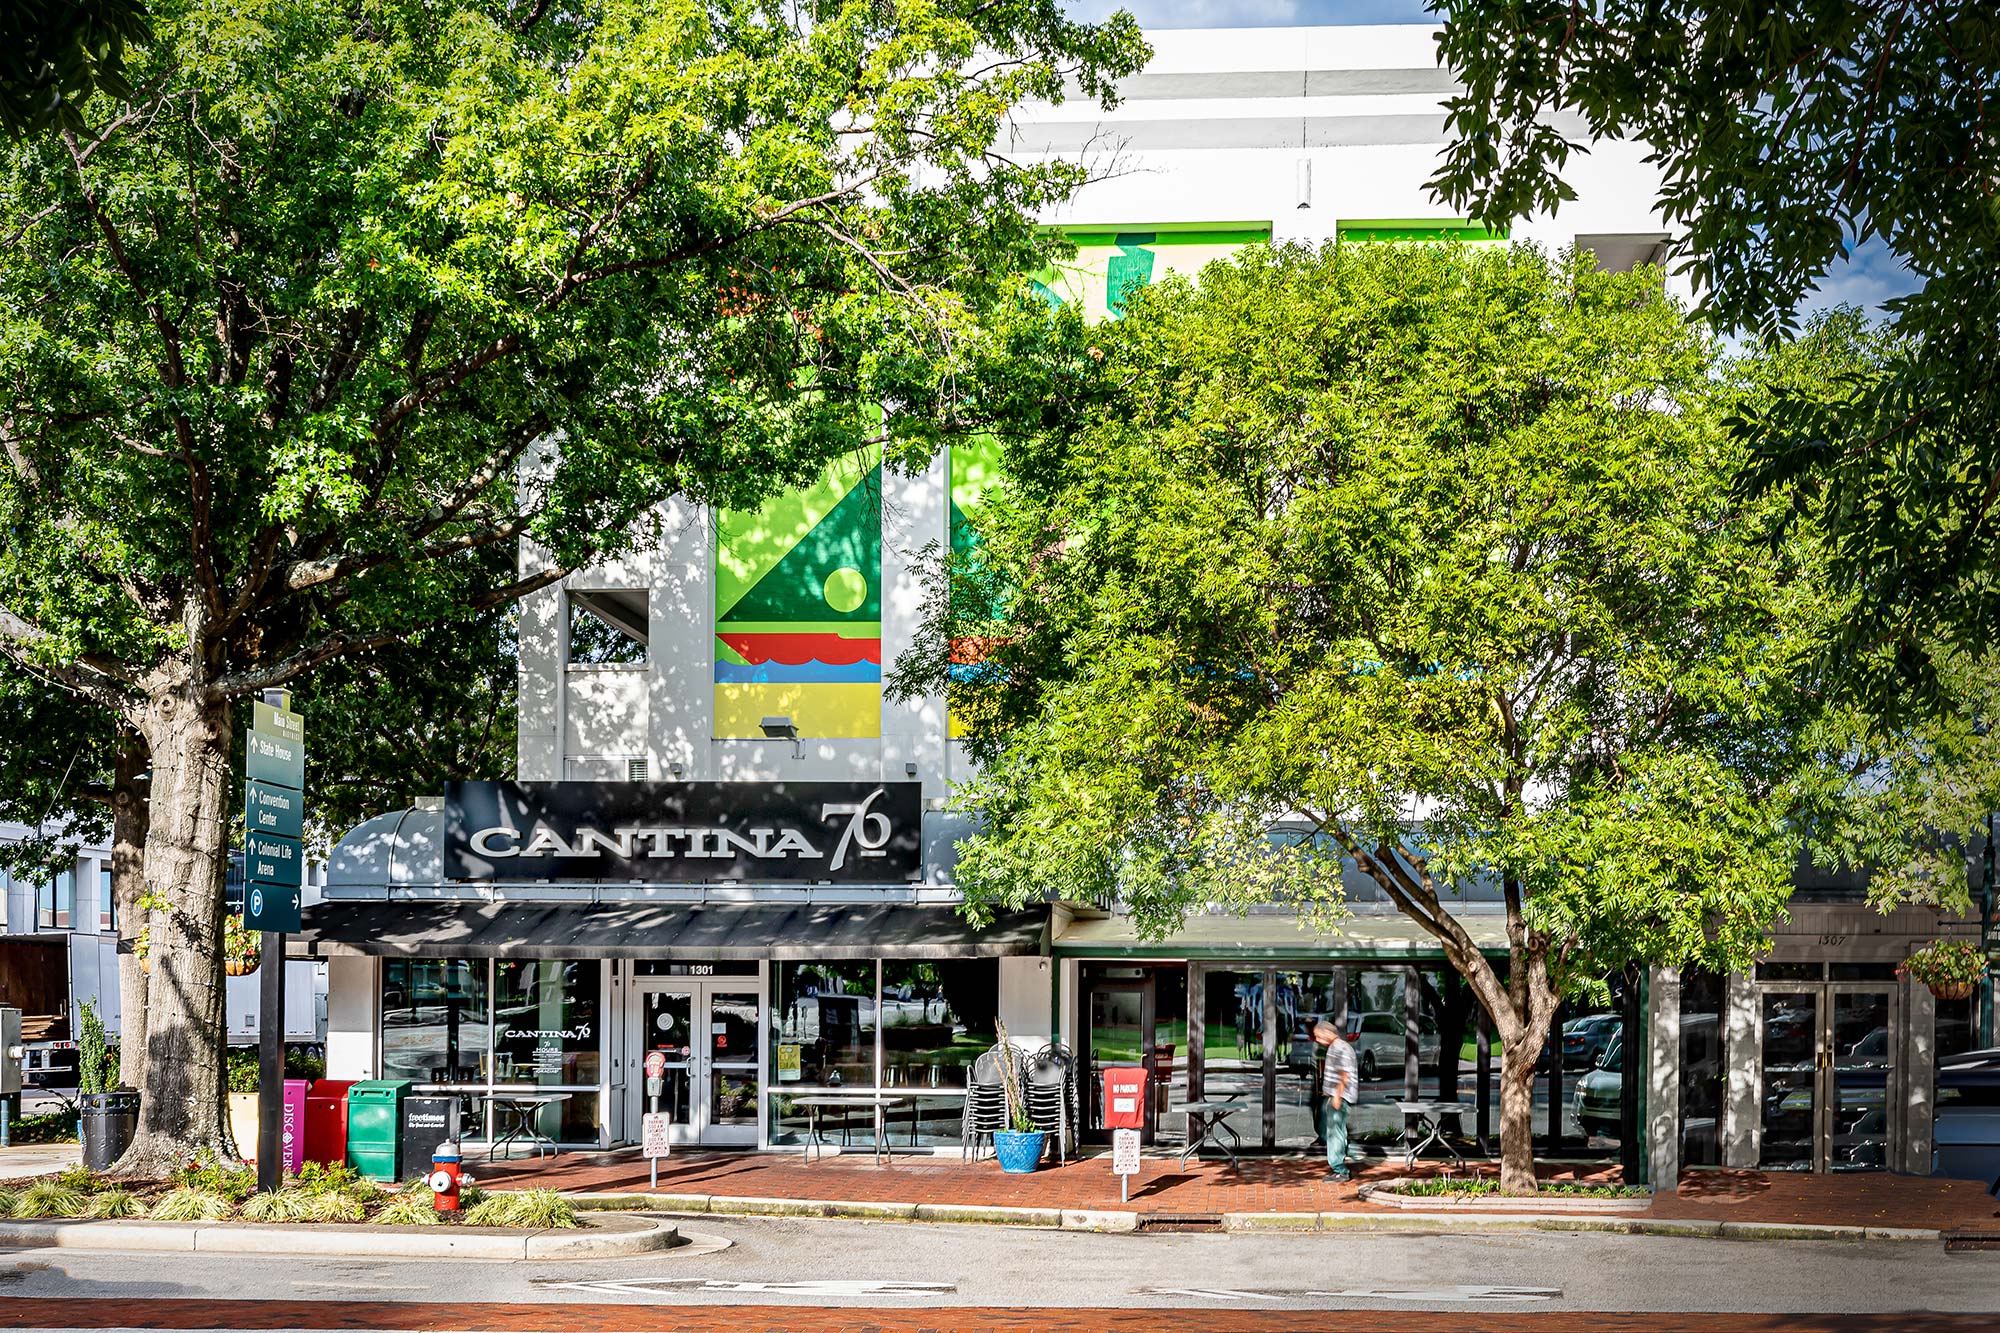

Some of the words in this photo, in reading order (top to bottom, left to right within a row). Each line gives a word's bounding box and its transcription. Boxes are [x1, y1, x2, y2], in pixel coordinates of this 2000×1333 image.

[273, 711, 285, 728] Main
[286, 715, 300, 732] Street
[260, 740, 274, 757] State
[275, 743, 292, 761] House
[259, 790, 290, 810] Convention
[258, 809, 277, 827] Center
[469, 826, 823, 860] CANTINA
[821, 787, 892, 872] 76
[258, 840, 280, 858] Colonial
[281, 844, 292, 860] Life
[257, 860, 274, 877] Arena
[1818, 935, 1846, 946] 1307
[690, 964, 713, 975] 1301
[504, 1030, 577, 1038] CANTINA
[575, 1022, 591, 1041] 76
[1113, 1084, 1119, 1093] NO
[1120, 1084, 1138, 1093] PARKING
